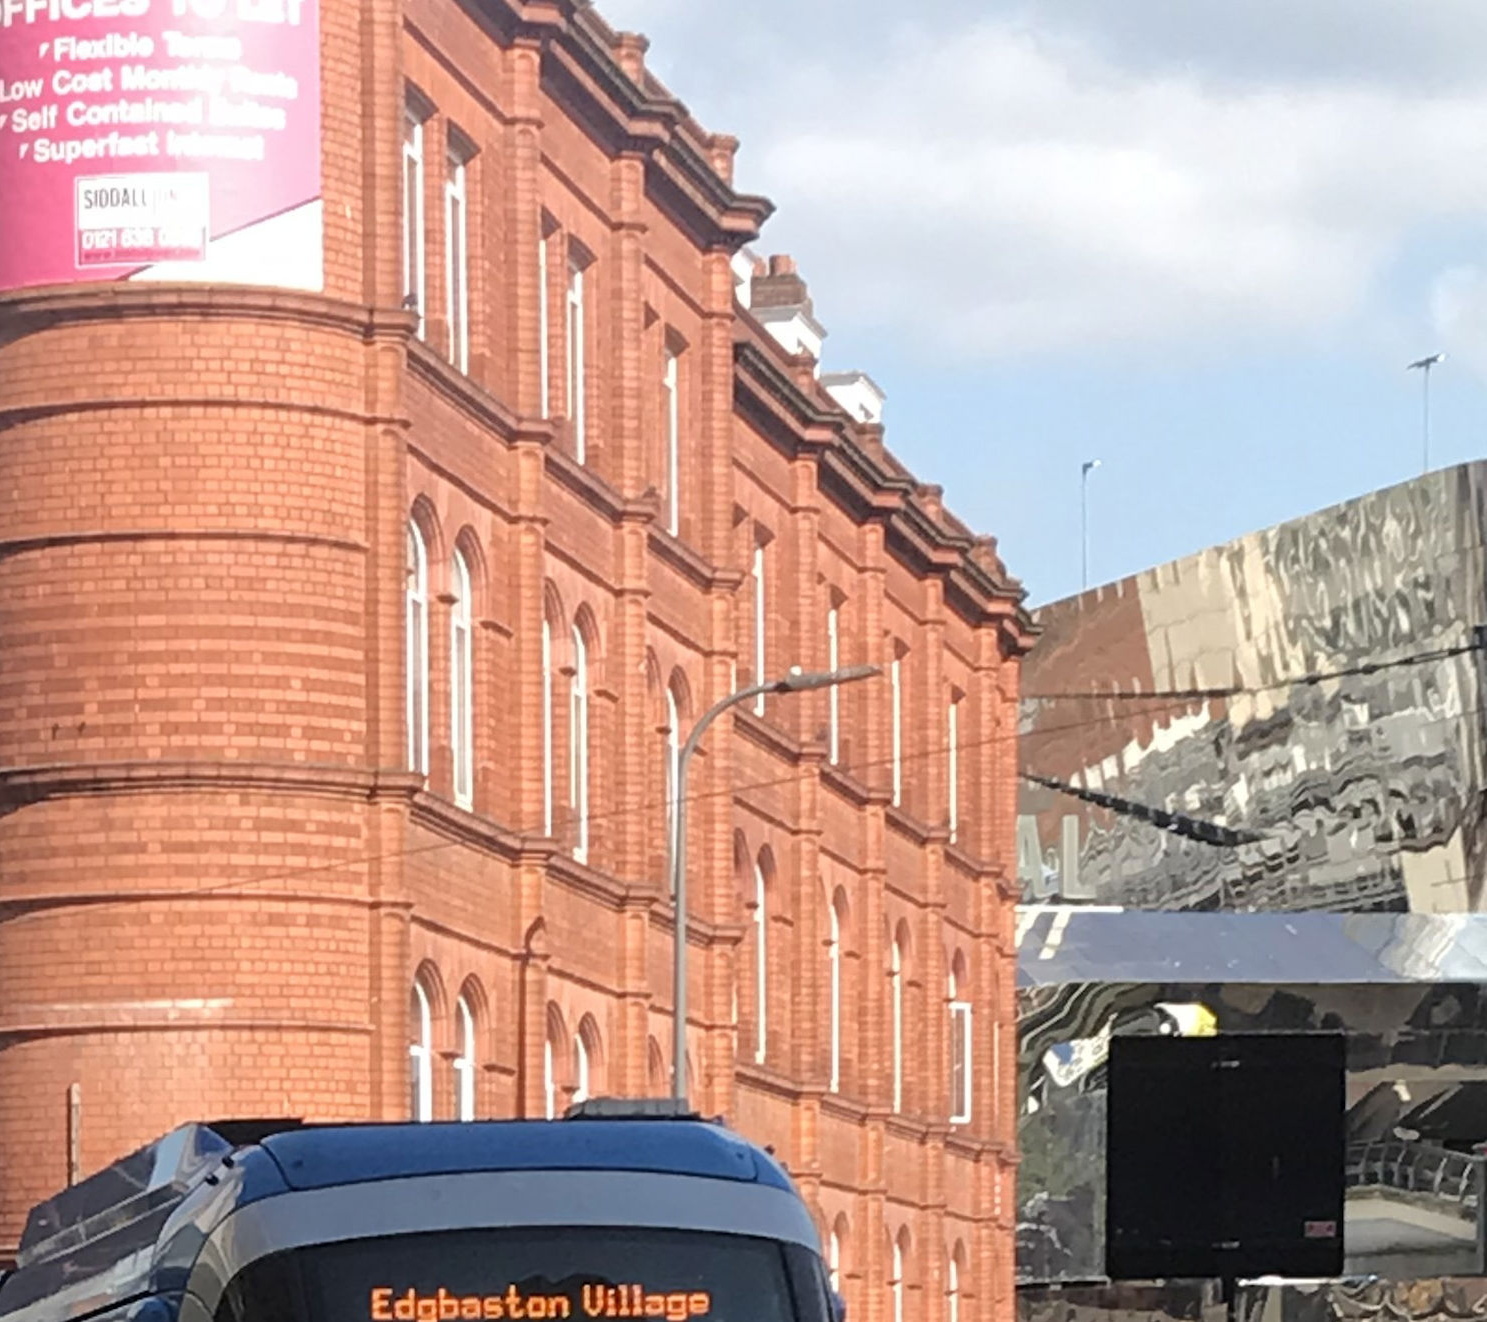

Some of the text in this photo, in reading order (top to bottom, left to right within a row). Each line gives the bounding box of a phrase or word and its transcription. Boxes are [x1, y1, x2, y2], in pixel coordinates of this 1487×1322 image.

[54, 32, 154, 62] Flexible
[52, 67, 113, 95] Cost
[11, 105, 58, 133] Self
[66, 97, 203, 128] Contained
[33, 133, 160, 164] Superfast
[582, 1284, 710, 1322] Village
